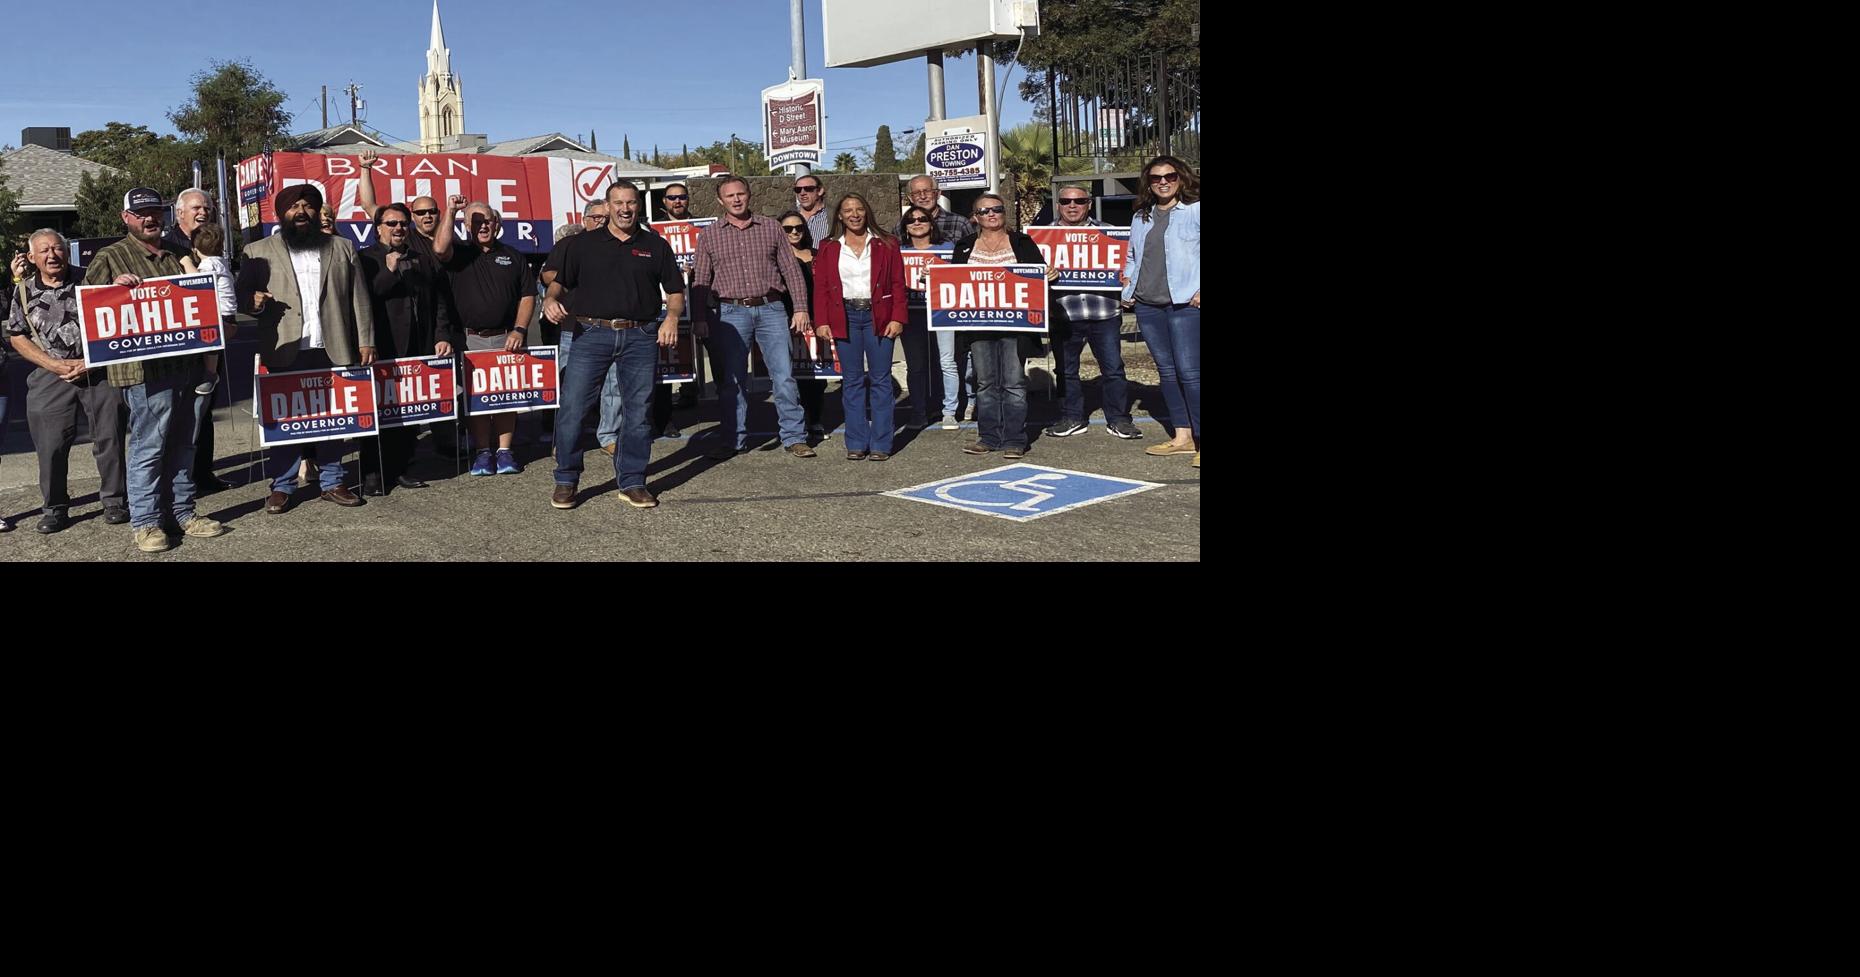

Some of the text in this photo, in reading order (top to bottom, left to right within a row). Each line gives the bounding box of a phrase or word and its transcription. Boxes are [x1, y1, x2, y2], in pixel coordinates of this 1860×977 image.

[778, 104, 804, 114] Historic
[780, 112, 806, 123] D Street
[780, 124, 817, 136] Mary Aaron
[780, 134, 809, 144] Museum
[773, 151, 817, 163] DOWNTOWN
[930, 148, 978, 162] PRESTON
[327, 157, 477, 176] BRIAN
[942, 160, 966, 168] TOWING
[930, 167, 980, 177] 530-755-4385
[1065, 233, 1088, 242] VOTE
[904, 256, 924, 265] VOTE
[970, 271, 994, 281] VOTE
[1060, 271, 1115, 279] VERNOR
[178, 277, 206, 286] NOVEMBER
[130, 286, 157, 300] VOTE
[939, 282, 1029, 308] DAHLE
[94, 296, 200, 338] DAHLE
[948, 311, 1023, 319] GOVERNOR
[108, 330, 196, 350] GOVERNOR
[496, 355, 516, 364] VOTE
[392, 365, 412, 376] VOTE
[300, 376, 322, 388] VOTE
[472, 364, 544, 394] DAHLE
[270, 386, 358, 420] DAHLE
[480, 392, 538, 403] GOVERNOR
[280, 416, 354, 431] GOVERNOR
